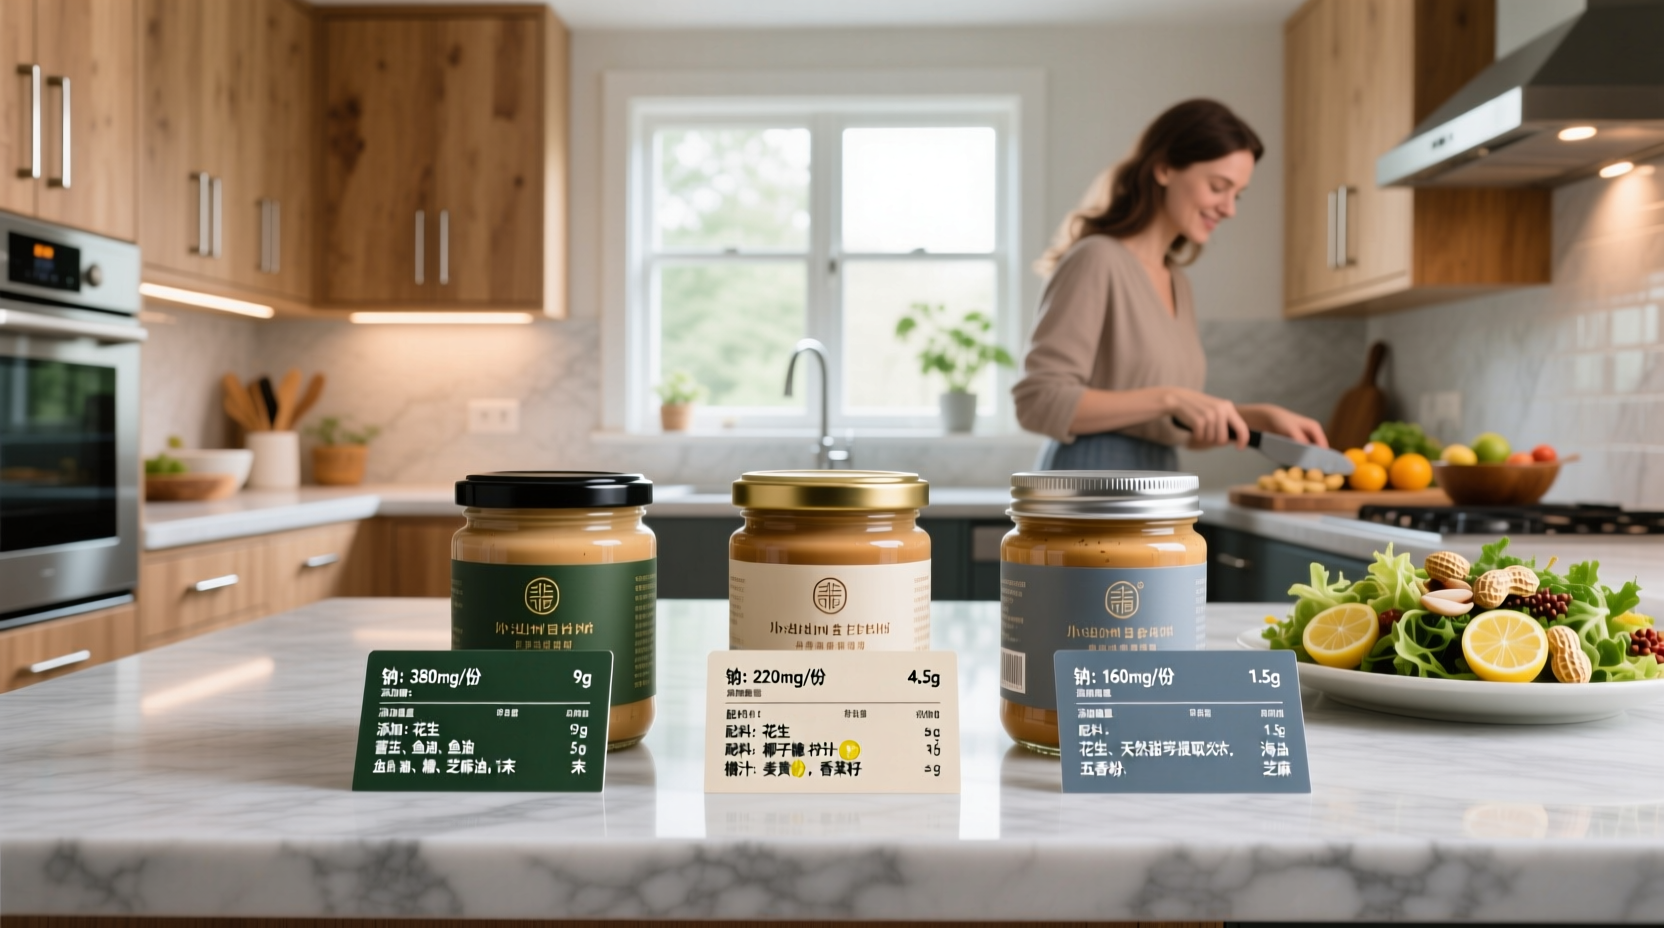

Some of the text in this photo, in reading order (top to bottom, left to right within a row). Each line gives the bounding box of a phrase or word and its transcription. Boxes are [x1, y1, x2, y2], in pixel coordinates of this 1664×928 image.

[573, 669, 592, 688] 9g
[908, 669, 940, 688] 4.5g
[1249, 669, 1280, 688] 1.5g
